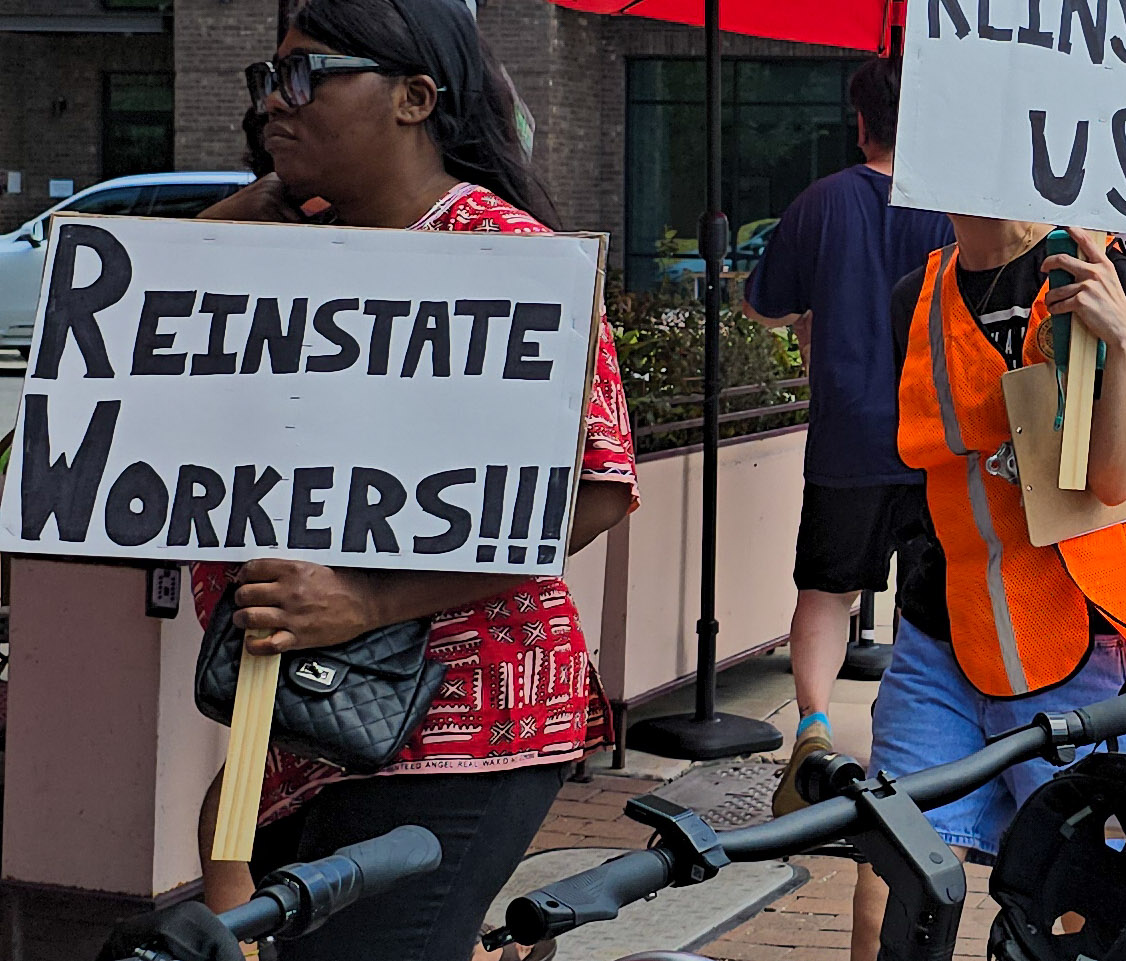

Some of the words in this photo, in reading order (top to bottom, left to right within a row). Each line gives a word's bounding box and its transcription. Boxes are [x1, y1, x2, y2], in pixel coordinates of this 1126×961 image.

[31, 224, 563, 381] REINSTATE
[20, 394, 571, 565] WORKERS!!!
[425, 760, 453, 769] ANGEL
